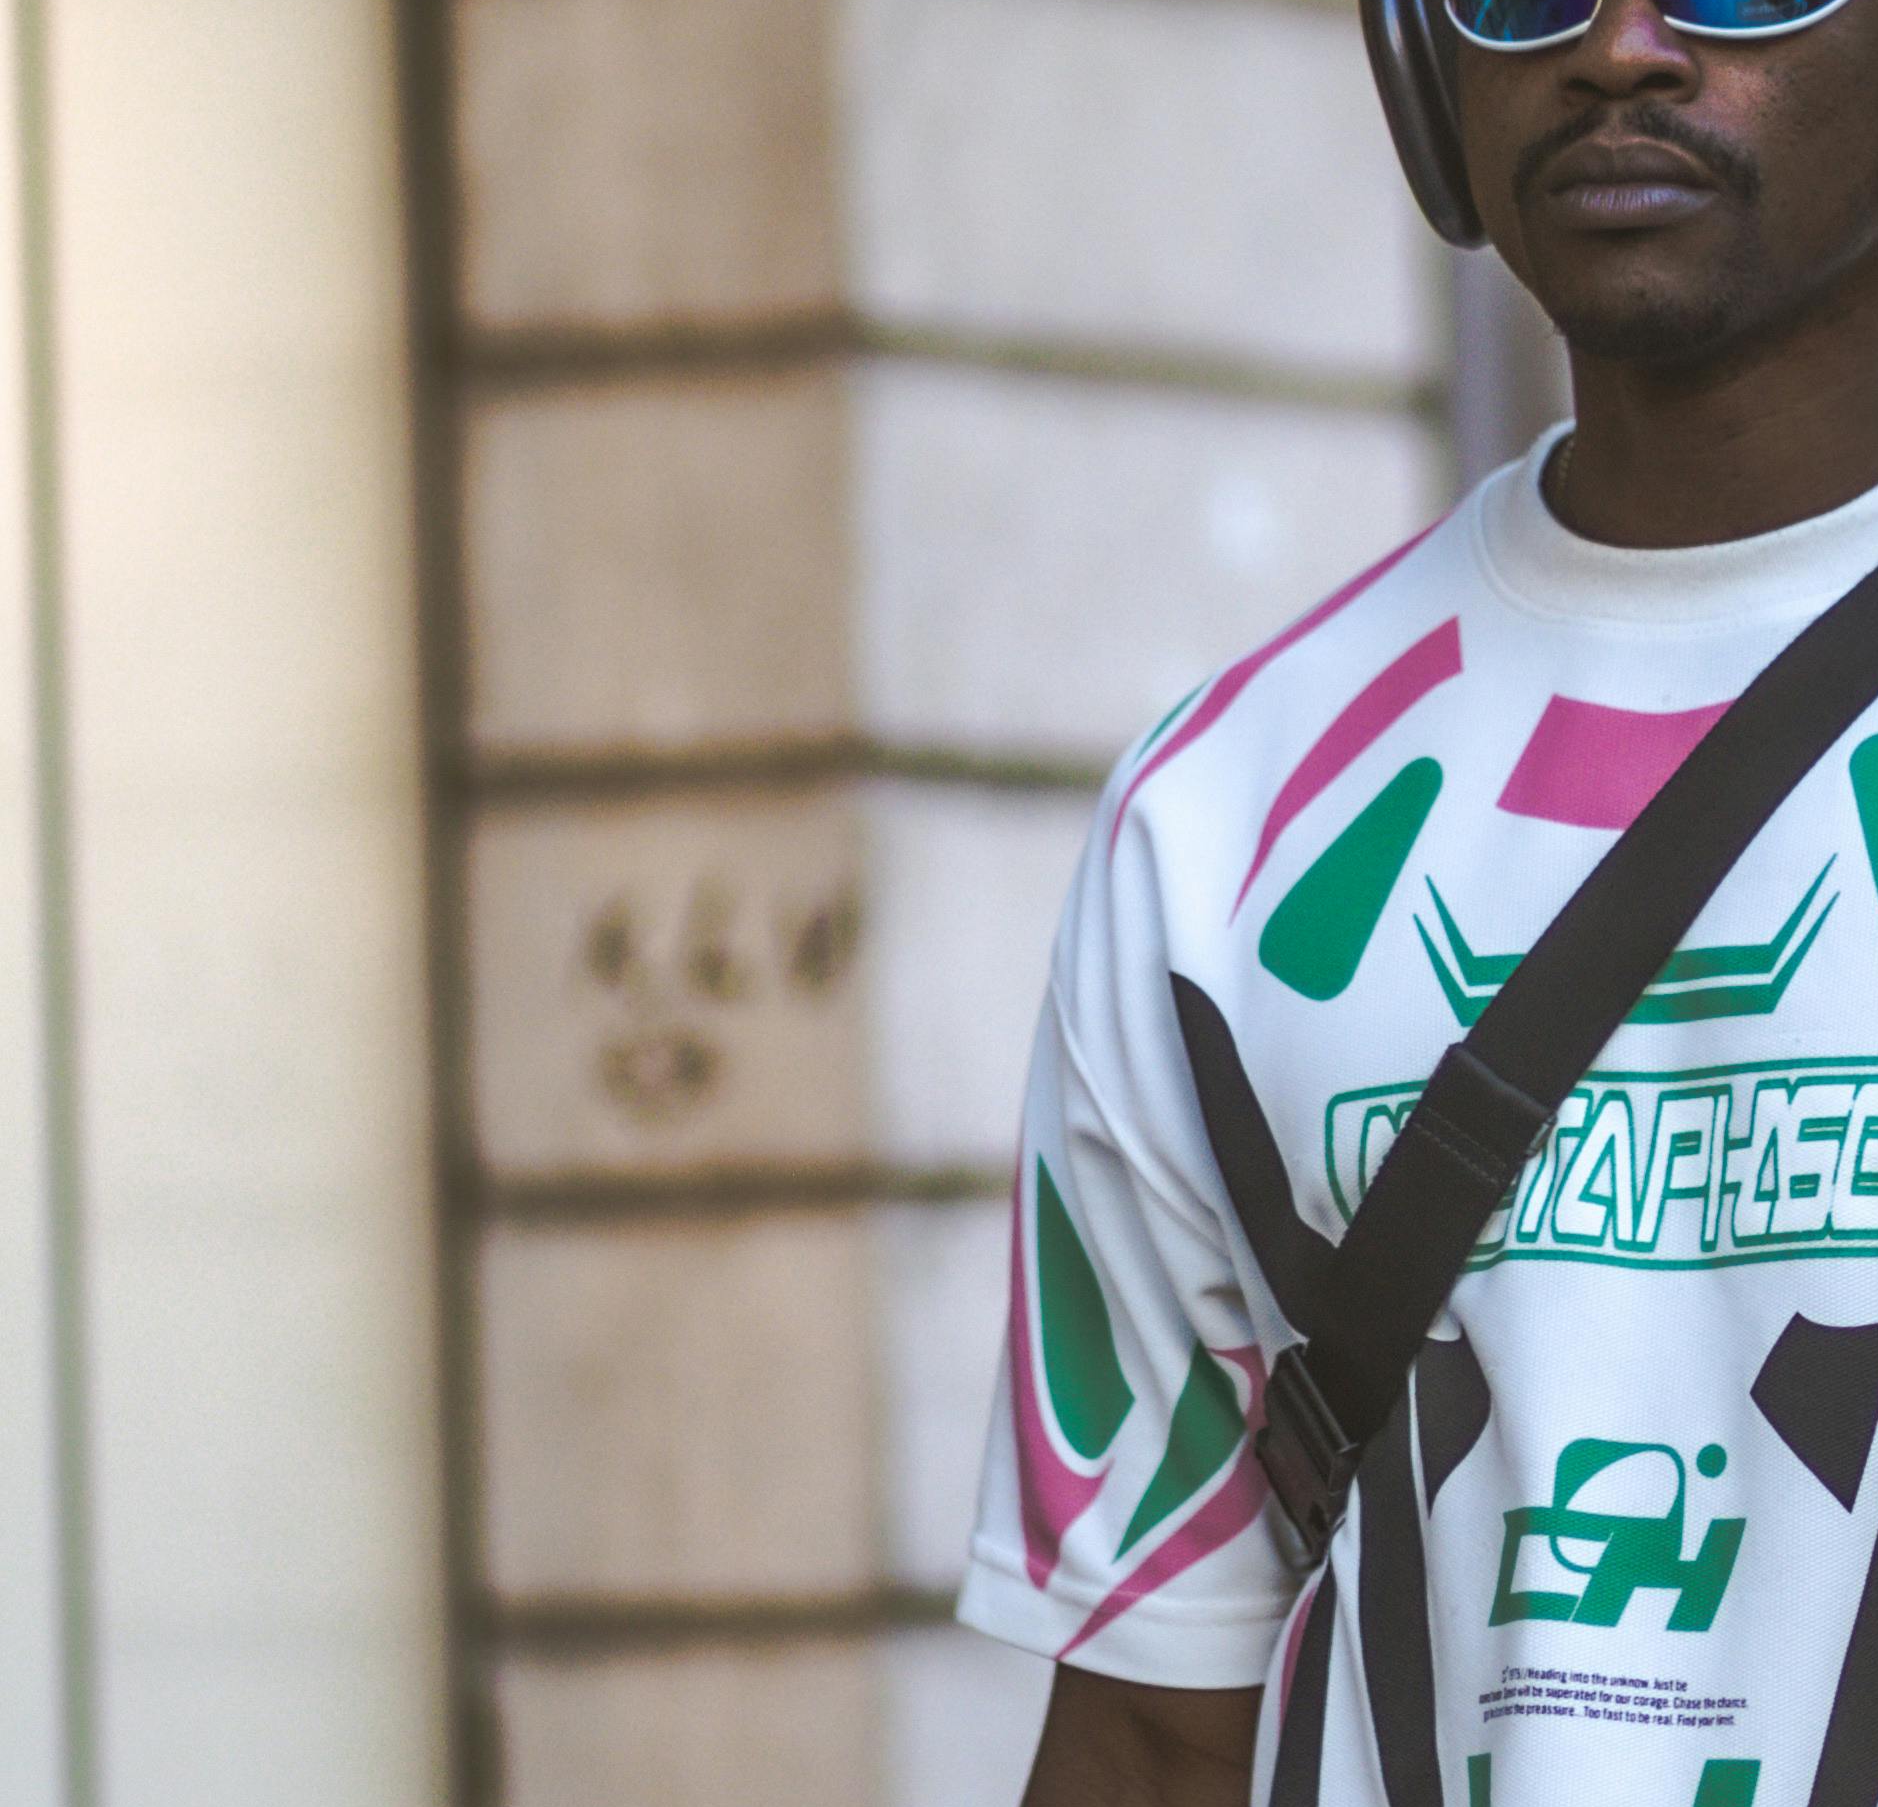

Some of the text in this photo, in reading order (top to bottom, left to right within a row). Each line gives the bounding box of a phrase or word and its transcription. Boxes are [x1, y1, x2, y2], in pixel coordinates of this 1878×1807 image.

[1570, 1670, 1590, 1684] into
[1591, 1673, 1607, 1686] the
[1653, 1677, 1673, 1691] Just
[1675, 1680, 1688, 1692] be
[1532, 1685, 1543, 1698] be
[1599, 1690, 1613, 1703] for
[1615, 1694, 1631, 1705] our
[1673, 1696, 1702, 1710] Chase
[1584, 1705, 1601, 1719] Too
[1603, 1708, 1623, 1721] fast
[1625, 1710, 1637, 1723] to
[1638, 1712, 1651, 1725] be
